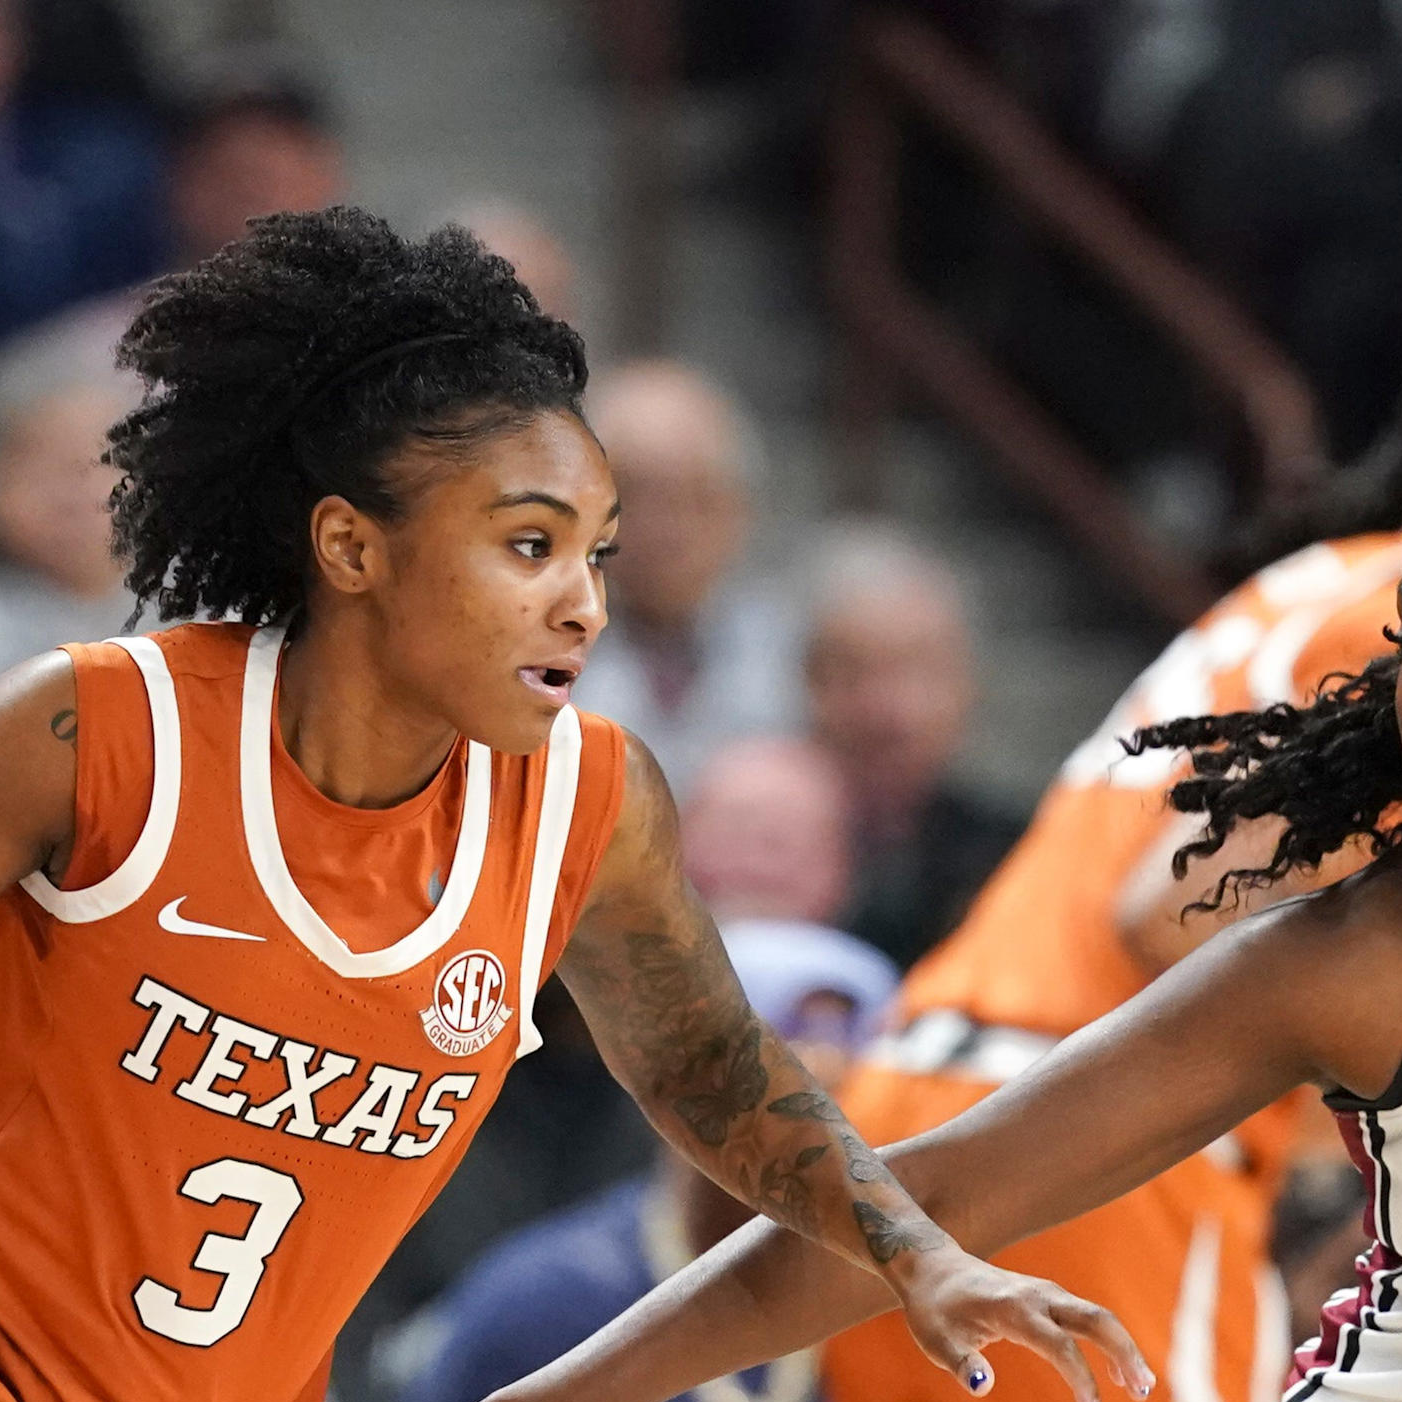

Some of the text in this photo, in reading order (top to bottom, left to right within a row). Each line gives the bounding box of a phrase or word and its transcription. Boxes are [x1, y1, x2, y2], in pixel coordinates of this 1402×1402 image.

[429, 1024, 498, 1055] GRADUATE
[440, 957, 503, 1032] SEC
[119, 974, 478, 1159] TEXAS
[132, 1157, 303, 1347] 3
